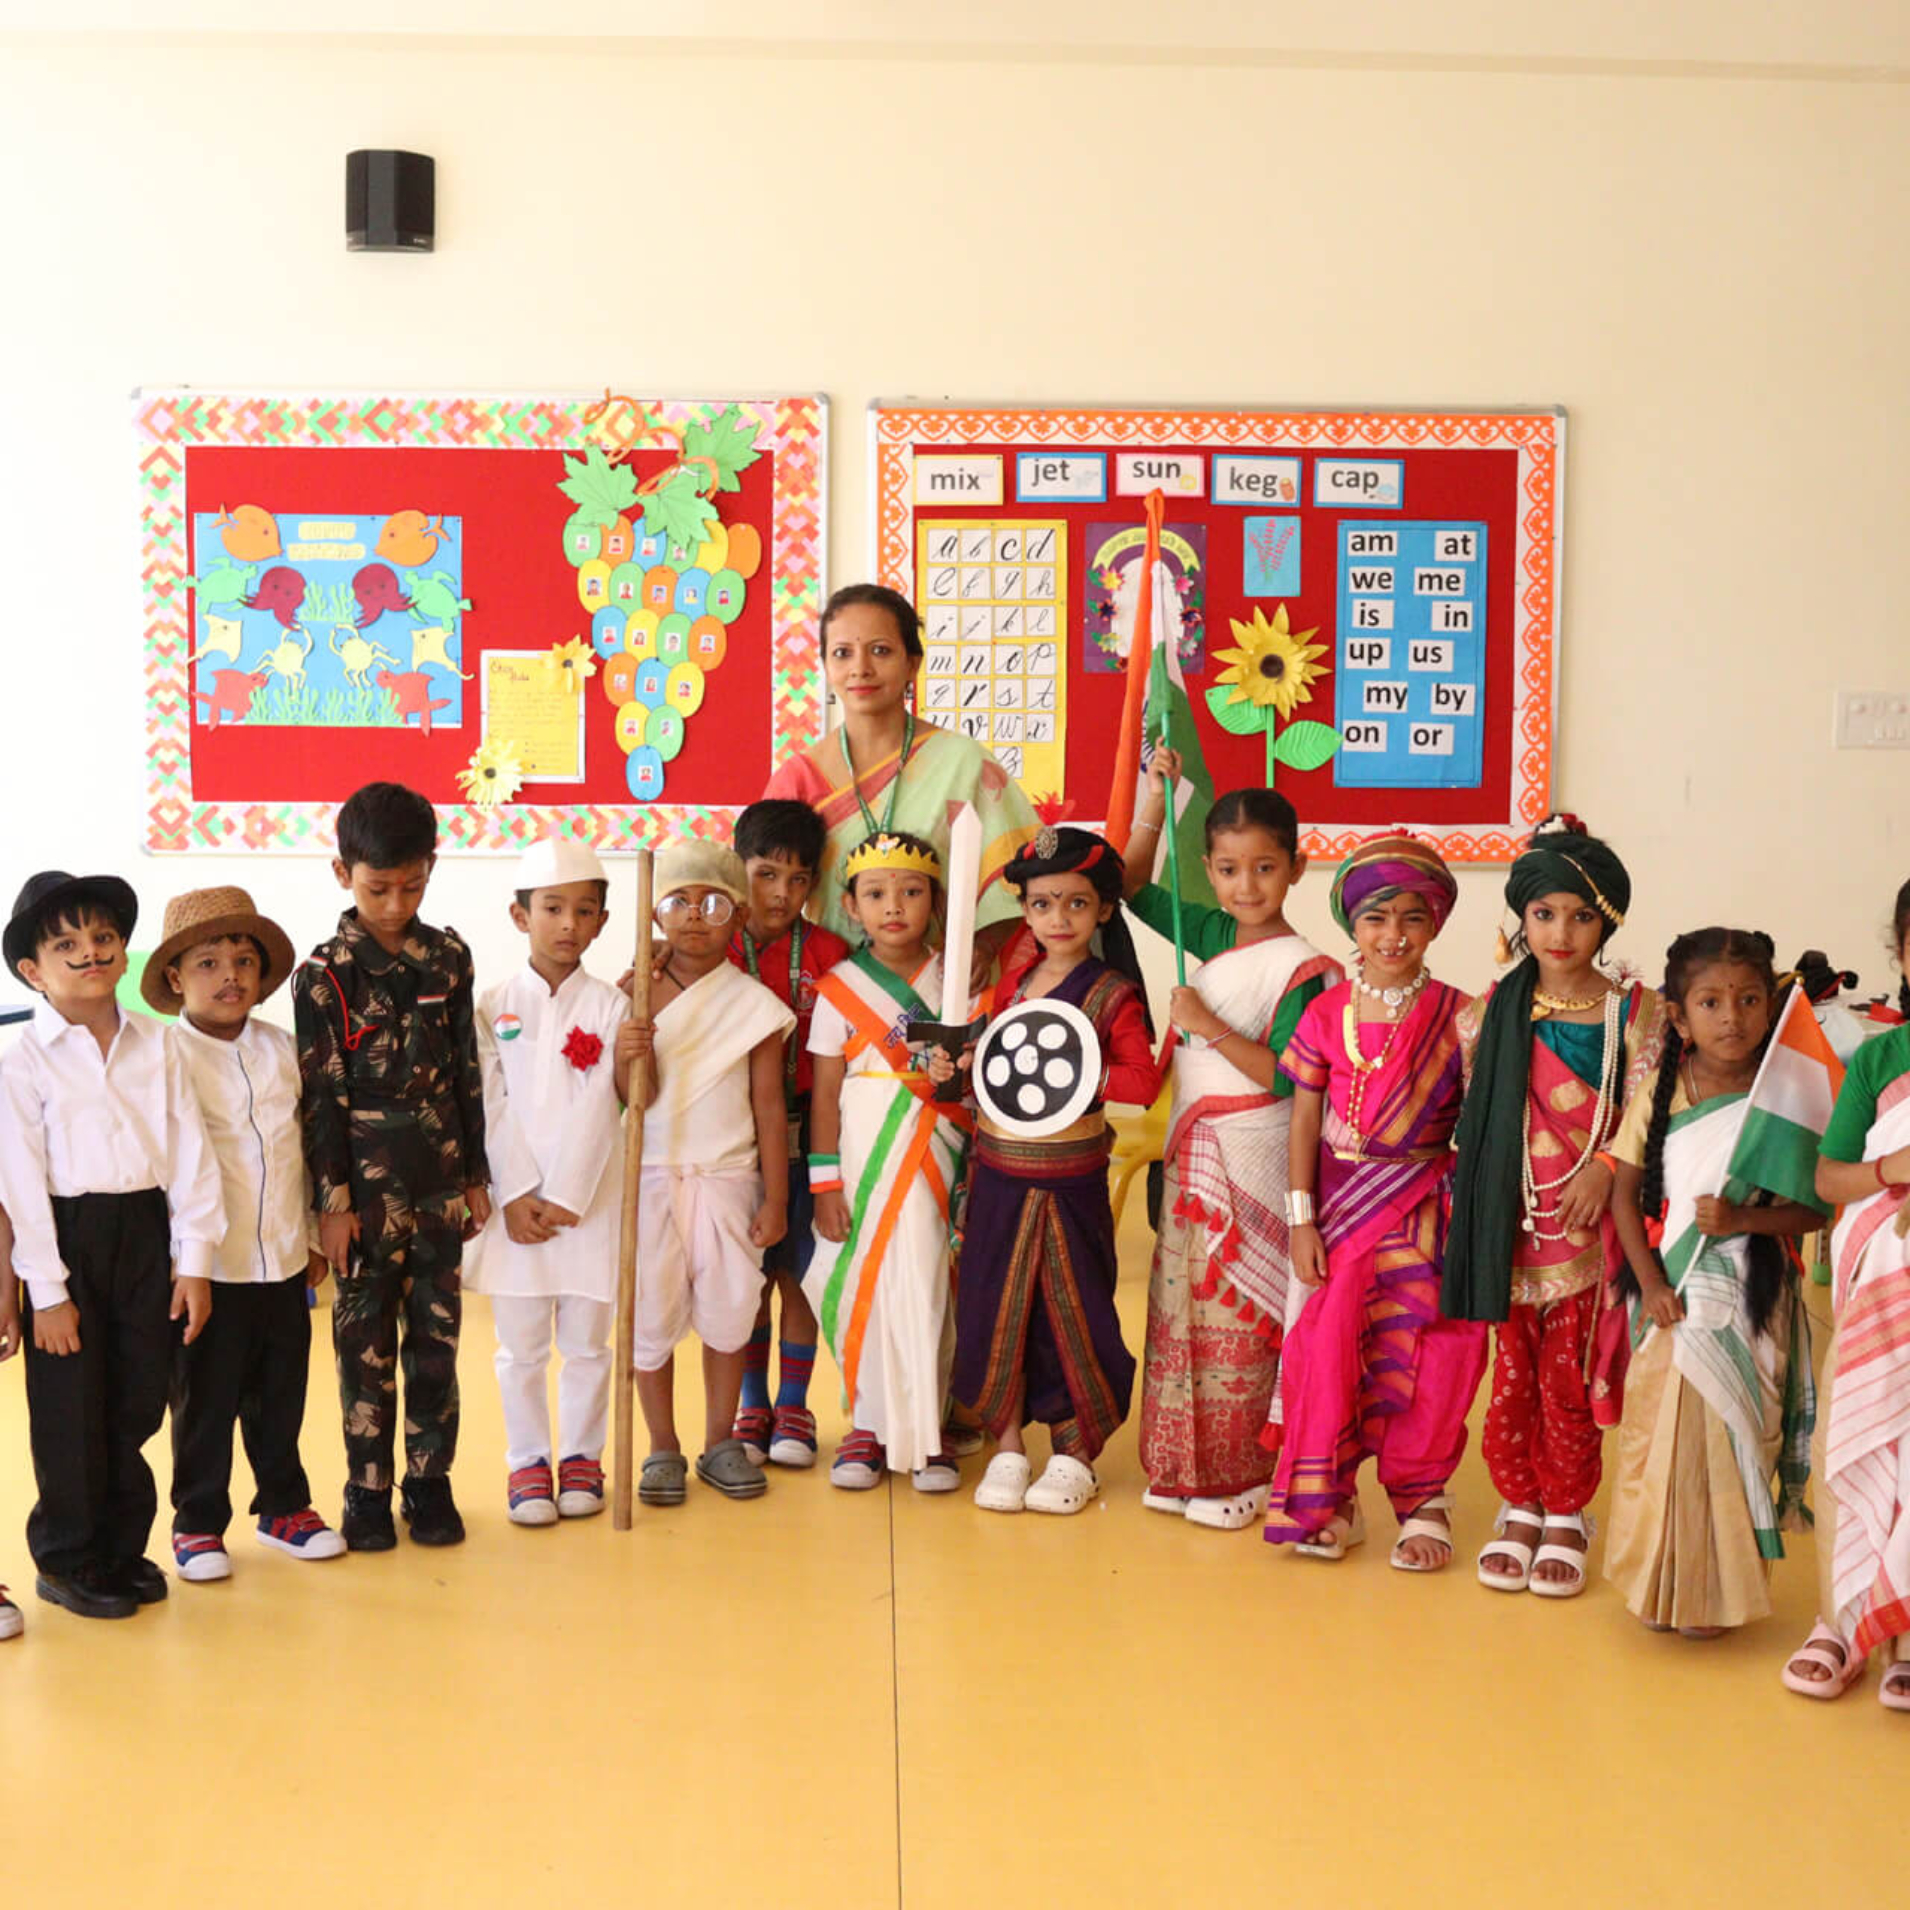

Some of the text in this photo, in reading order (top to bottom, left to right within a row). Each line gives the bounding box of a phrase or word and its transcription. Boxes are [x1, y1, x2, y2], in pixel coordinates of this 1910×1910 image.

[930, 468, 981, 491] mix
[1031, 459, 1071, 487] jet
[1132, 461, 1182, 479] sun
[1229, 466, 1278, 498] keg
[1331, 469, 1380, 494] cap
[1000, 538, 1021, 561] c
[1026, 529, 1056, 560] d
[1351, 534, 1472, 556] am at
[1351, 572, 1461, 592] we me
[1359, 602, 1469, 628] is in
[1349, 642, 1443, 667] up us
[1366, 682, 1467, 711] my by
[1344, 725, 1444, 746] on or
